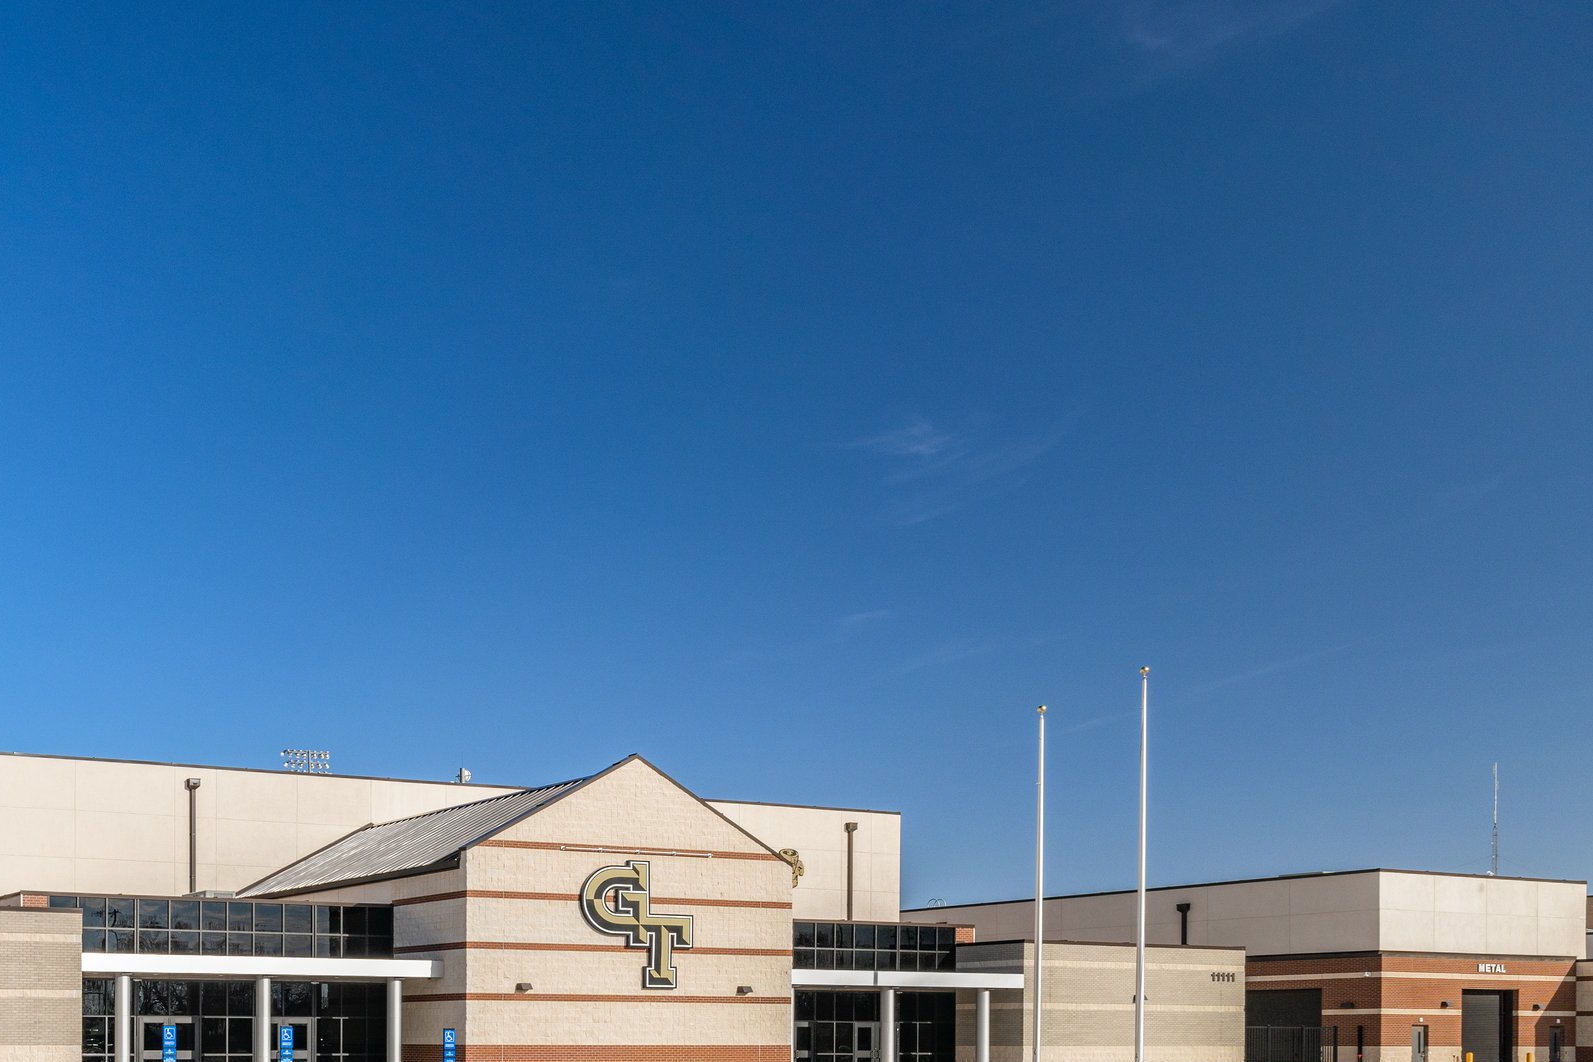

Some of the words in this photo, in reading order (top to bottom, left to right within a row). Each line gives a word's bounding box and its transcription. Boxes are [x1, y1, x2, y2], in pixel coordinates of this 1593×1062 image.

[580, 860, 694, 989] GT
[1477, 963, 1506, 973] METAL
[1211, 972, 1235, 982] 11111
